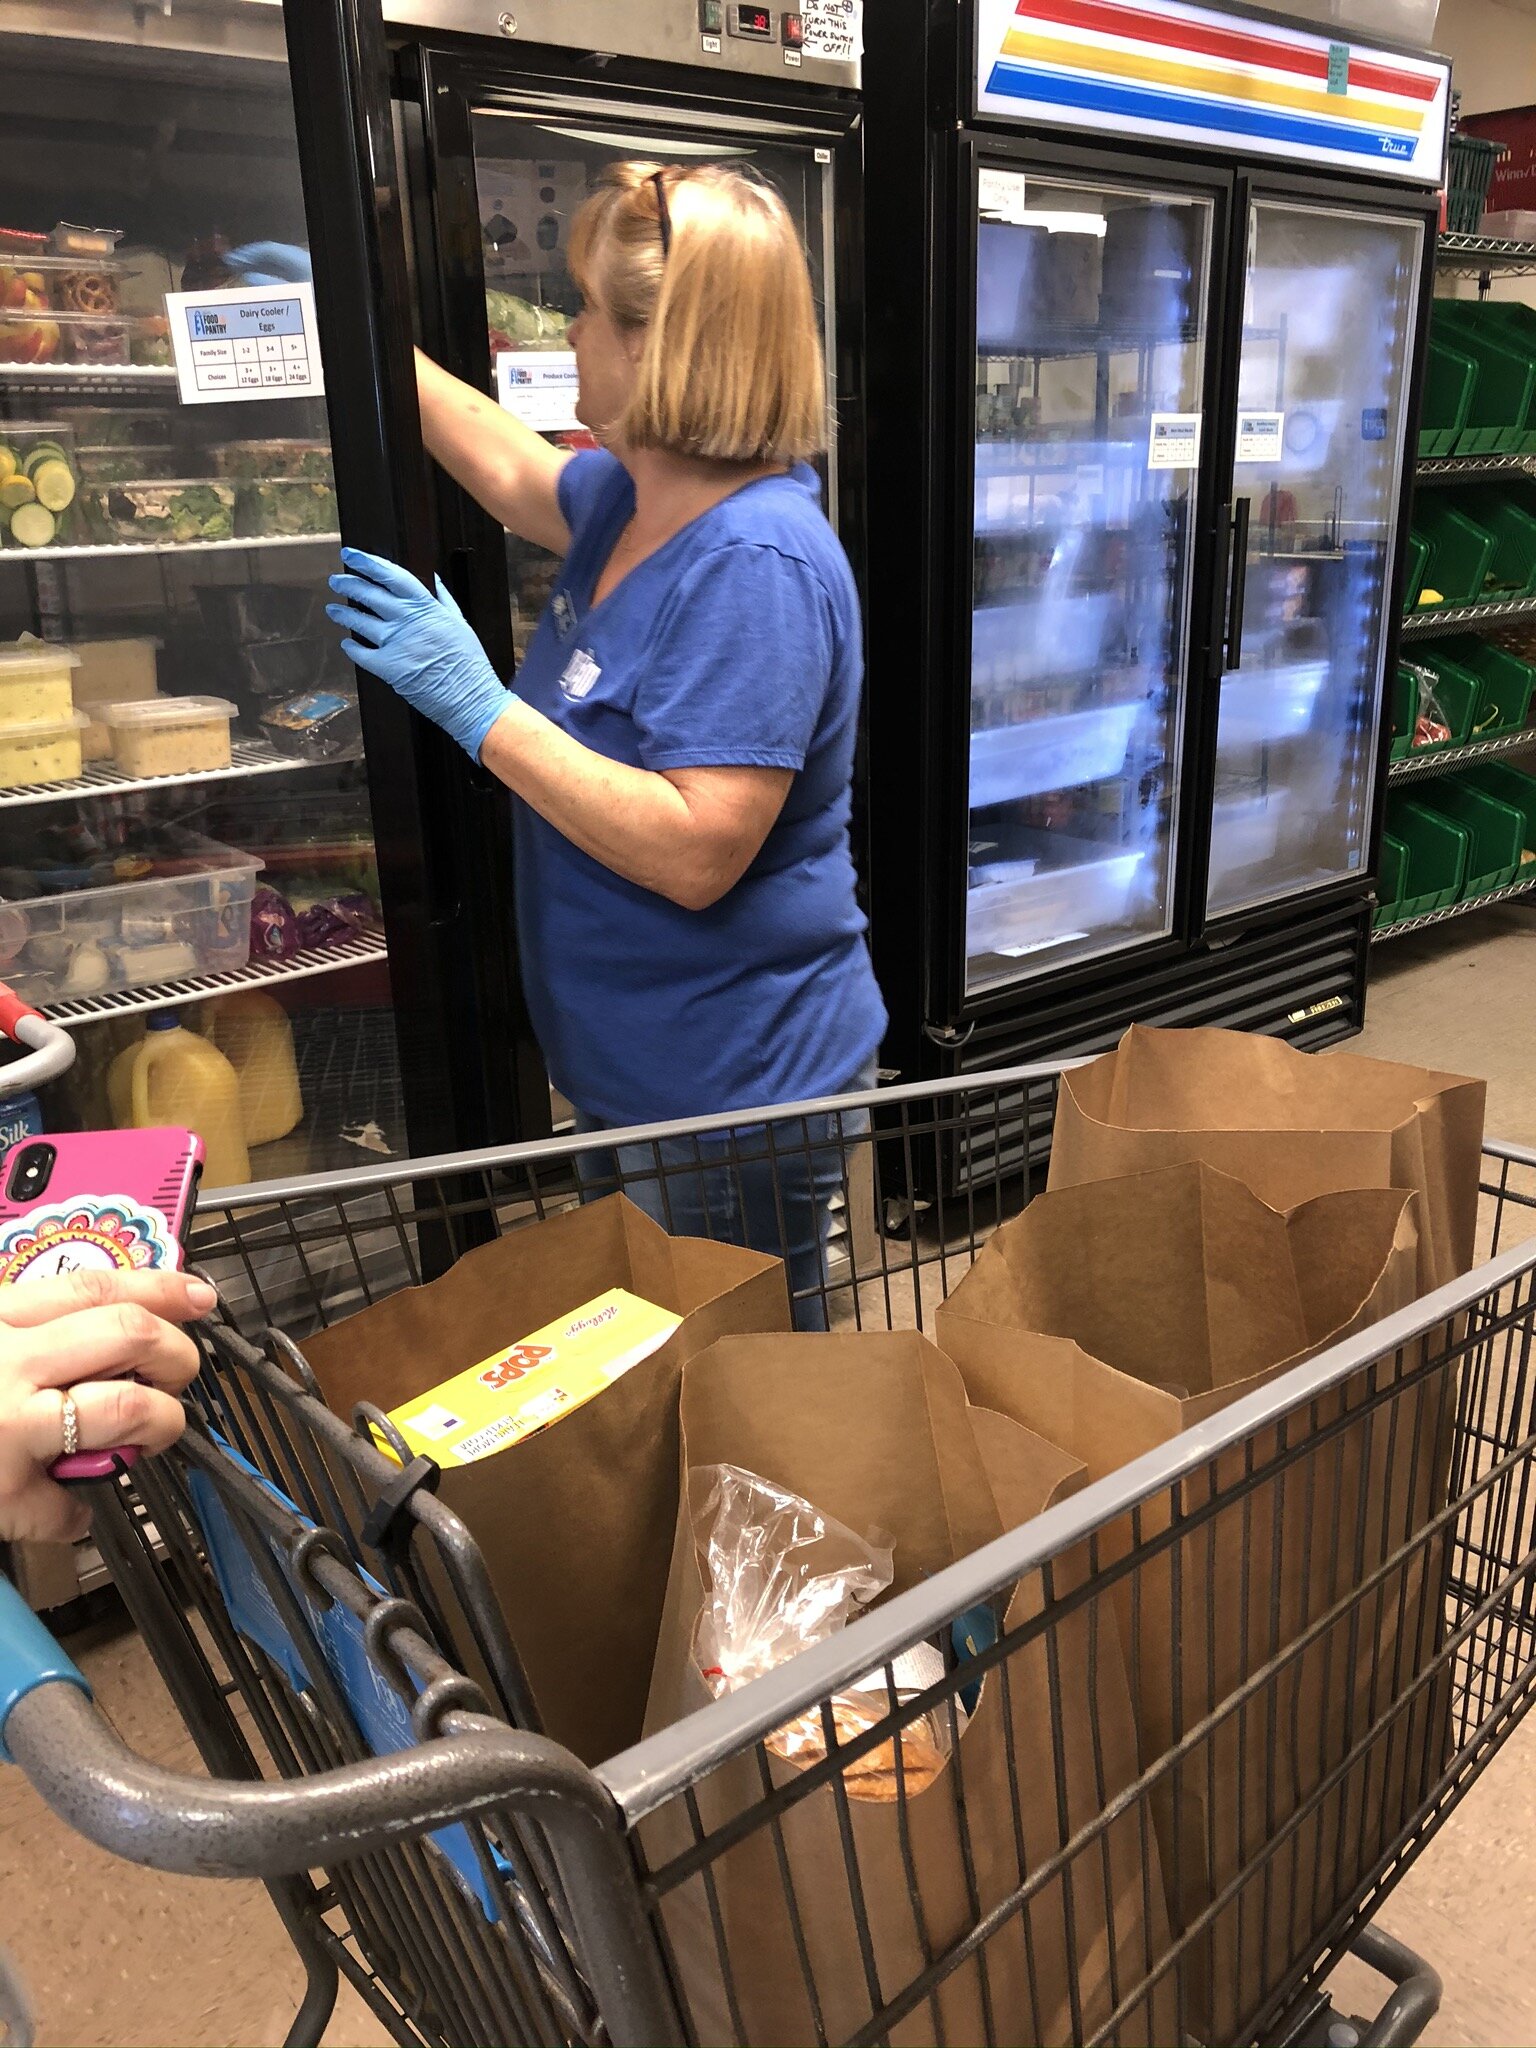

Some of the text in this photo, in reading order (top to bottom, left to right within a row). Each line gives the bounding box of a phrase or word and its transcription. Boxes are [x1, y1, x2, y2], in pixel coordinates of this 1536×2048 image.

[823, 4, 842, 14] NOT
[754, 15, 766, 26] 38
[802, 12, 847, 30] TURN THIS
[805, 24, 854, 43] POWER SWITCH
[823, 44, 850, 59] OFF!!
[786, 54, 800, 62] Power
[240, 310, 259, 318] Dairy
[261, 308, 284, 317] Cooler
[204, 315, 218, 324] FOOD
[204, 324, 227, 335] PANTRY
[259, 322, 275, 332] Eggs
[0, 1120, 30, 1152] Silk
[565, 1306, 618, 1338] Kellogg's
[482, 1344, 553, 1389] POPS
